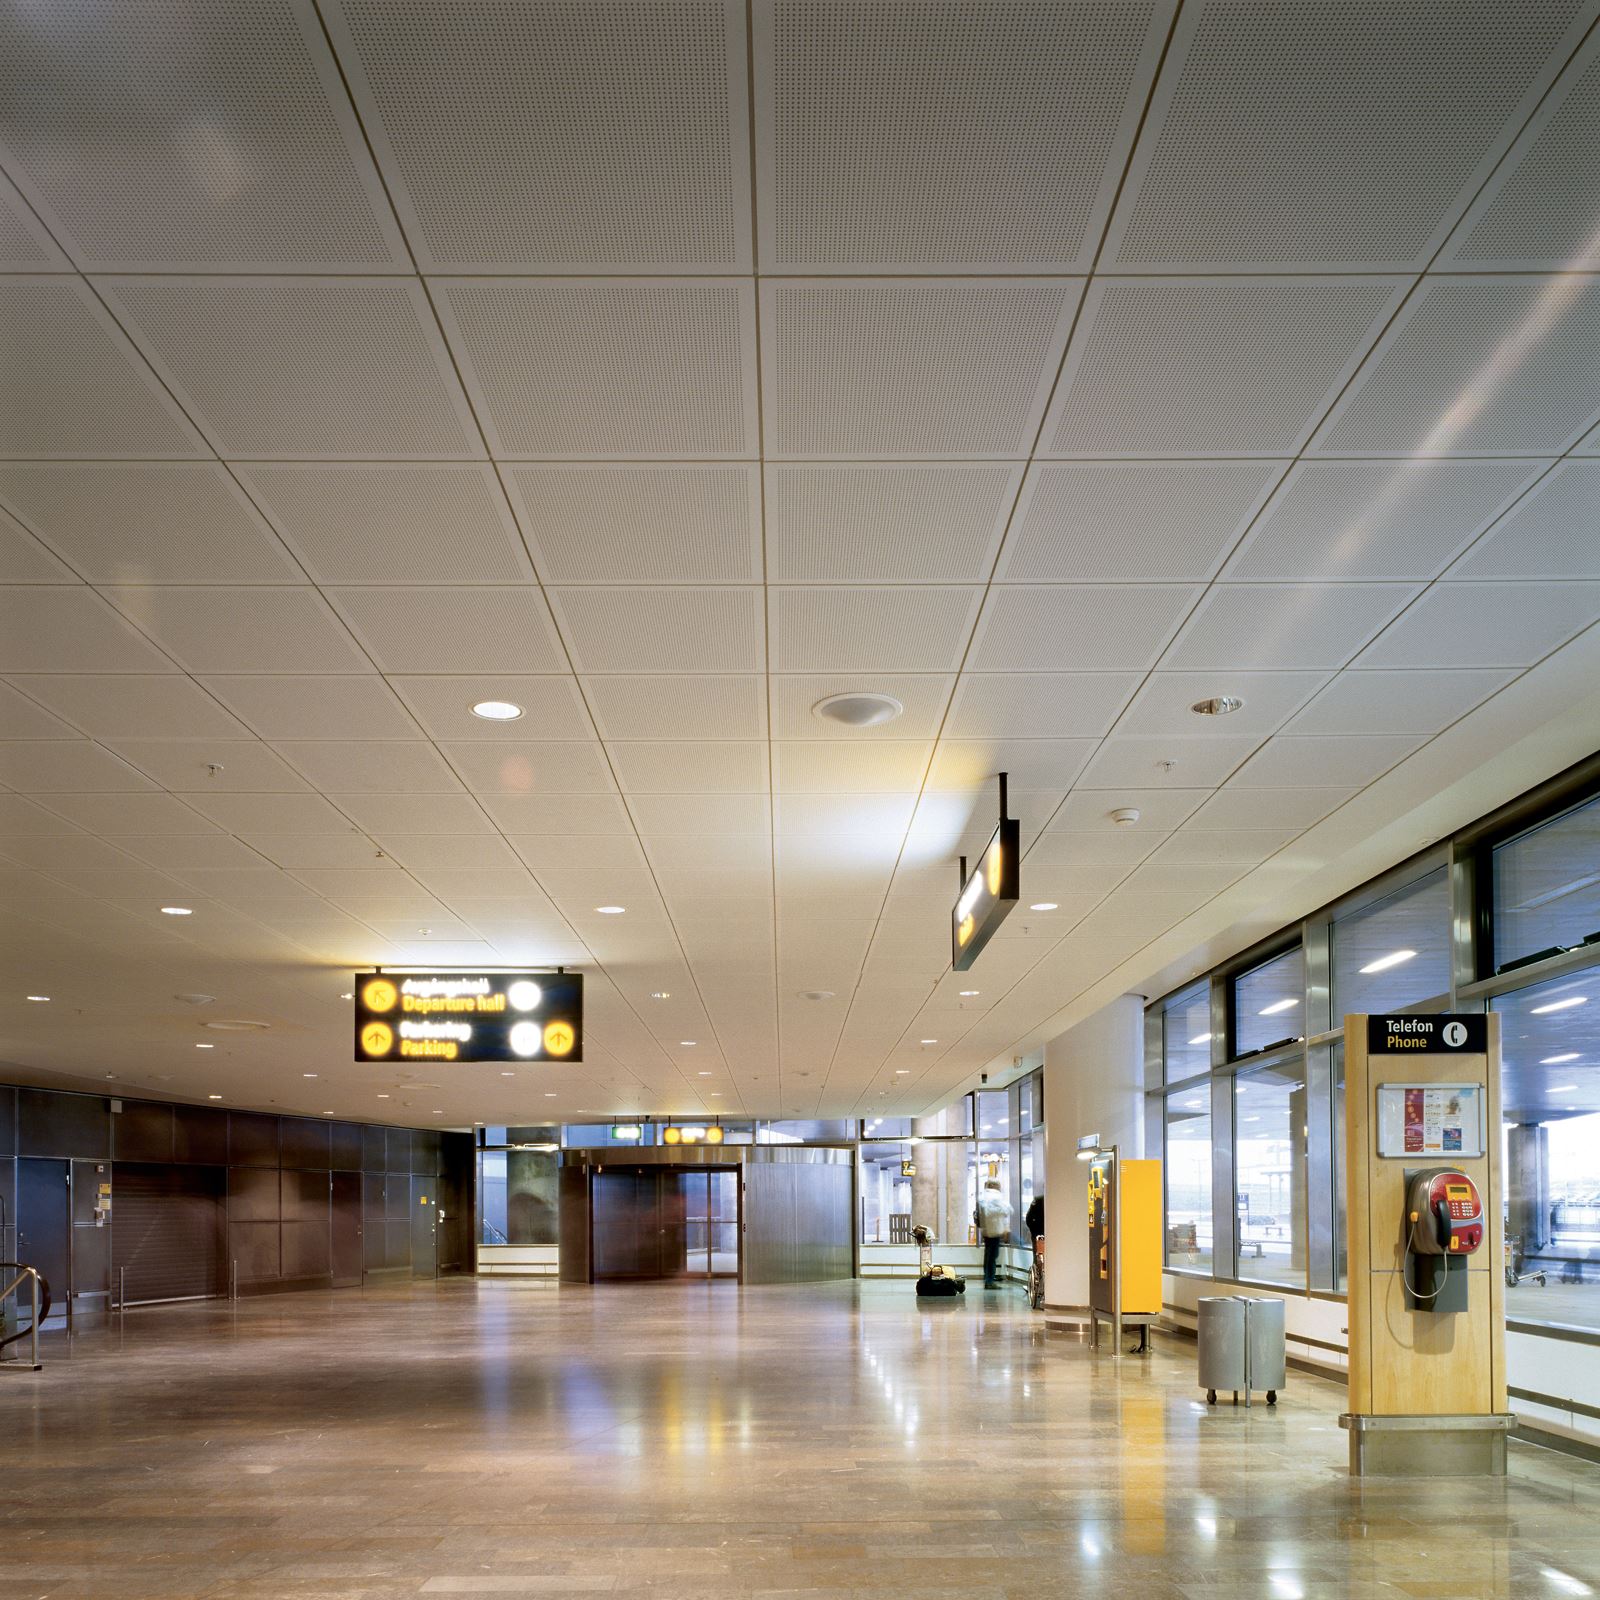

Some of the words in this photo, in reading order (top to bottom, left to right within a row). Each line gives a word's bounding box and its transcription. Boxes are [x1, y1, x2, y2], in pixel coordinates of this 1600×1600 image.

[402, 995, 475, 1014] Departure
[477, 993, 505, 1011] hall
[1386, 1019, 1433, 1032] Telefon
[401, 1039, 457, 1058] Parking
[1387, 1035, 1427, 1048] Phone
